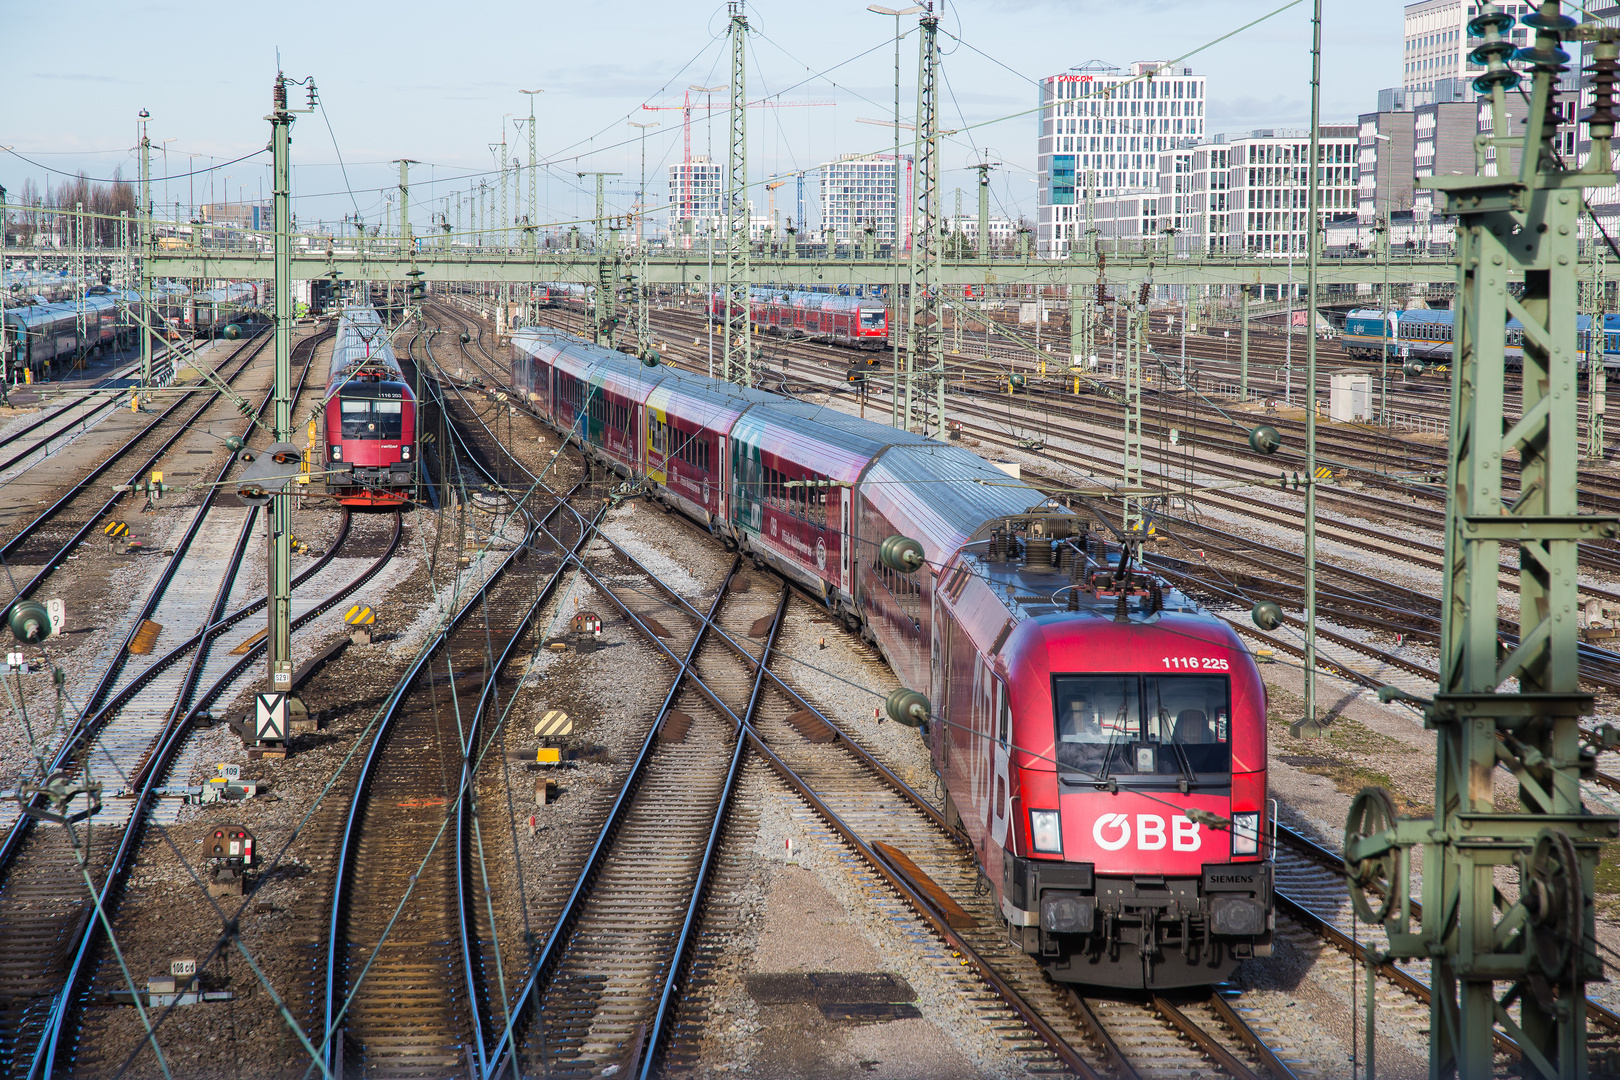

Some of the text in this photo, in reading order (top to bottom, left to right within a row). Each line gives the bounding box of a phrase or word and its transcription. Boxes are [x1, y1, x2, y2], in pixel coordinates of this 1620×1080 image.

[53, 615, 60, 626] 9
[1162, 656, 1229, 670] 1116 225
[226, 767, 237, 775] 109
[1092, 812, 1202, 852] ÖBB
[1210, 875, 1253, 884] SIEMENS
[172, 962, 184, 973] 108
